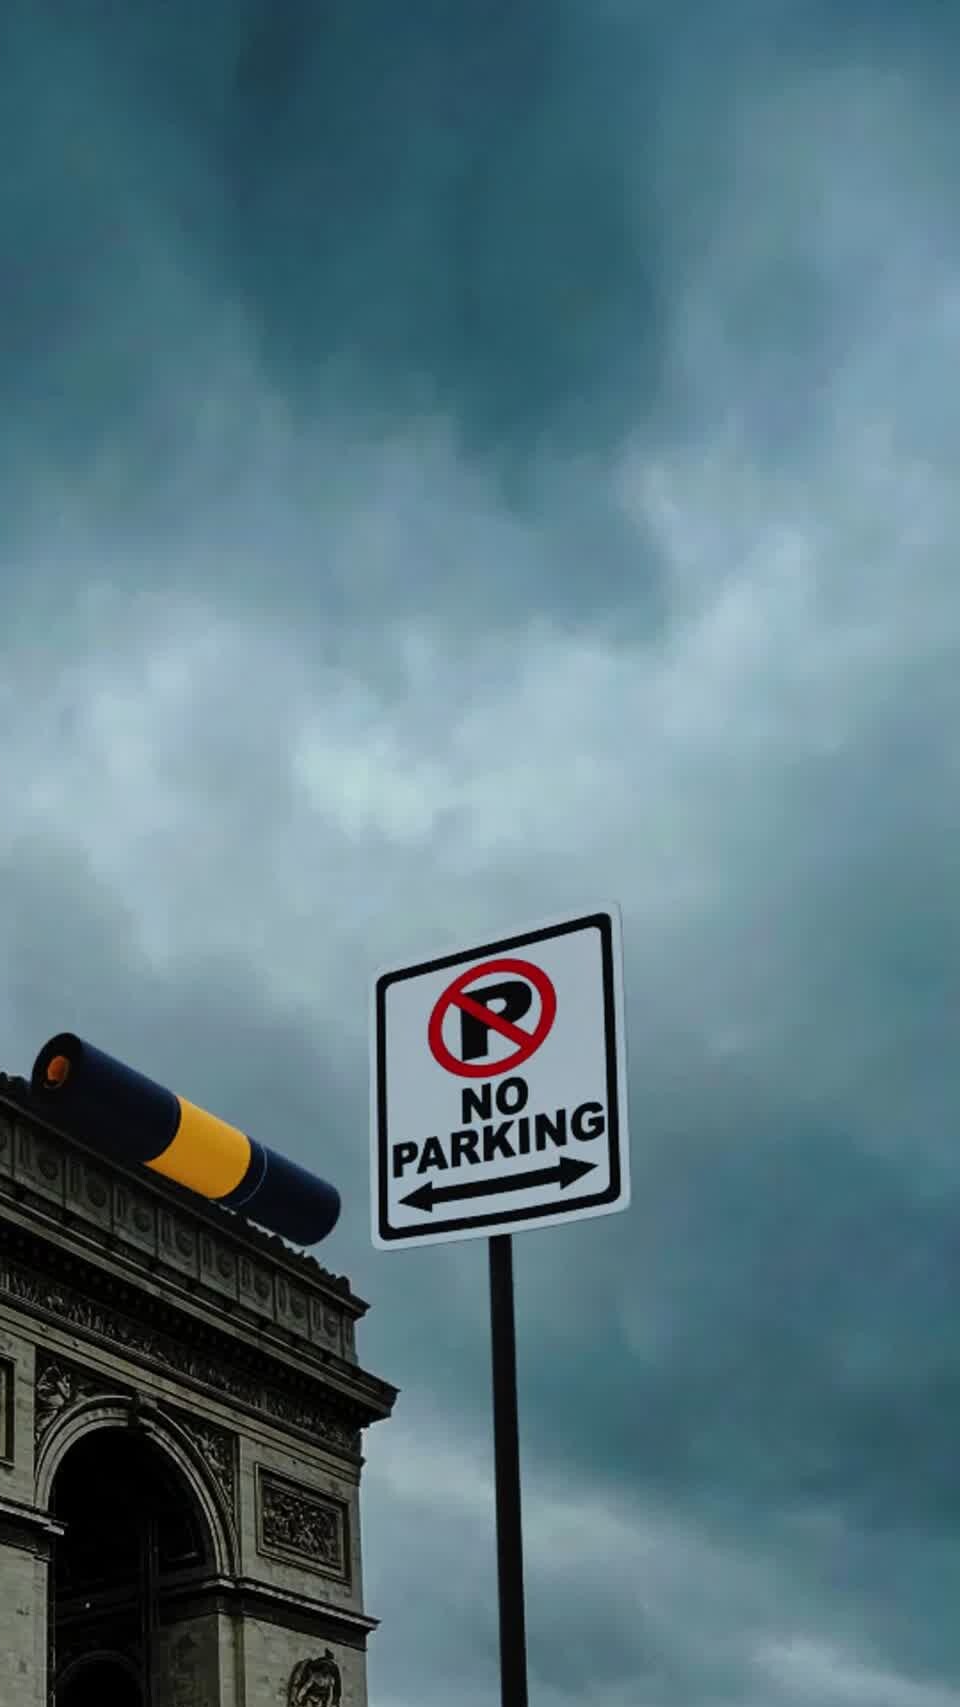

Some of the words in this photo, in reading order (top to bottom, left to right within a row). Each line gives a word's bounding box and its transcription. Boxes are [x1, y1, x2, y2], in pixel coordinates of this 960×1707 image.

[460, 980, 532, 1061] P
[461, 1077, 528, 1124] NO
[392, 1101, 605, 1178] PARKING
